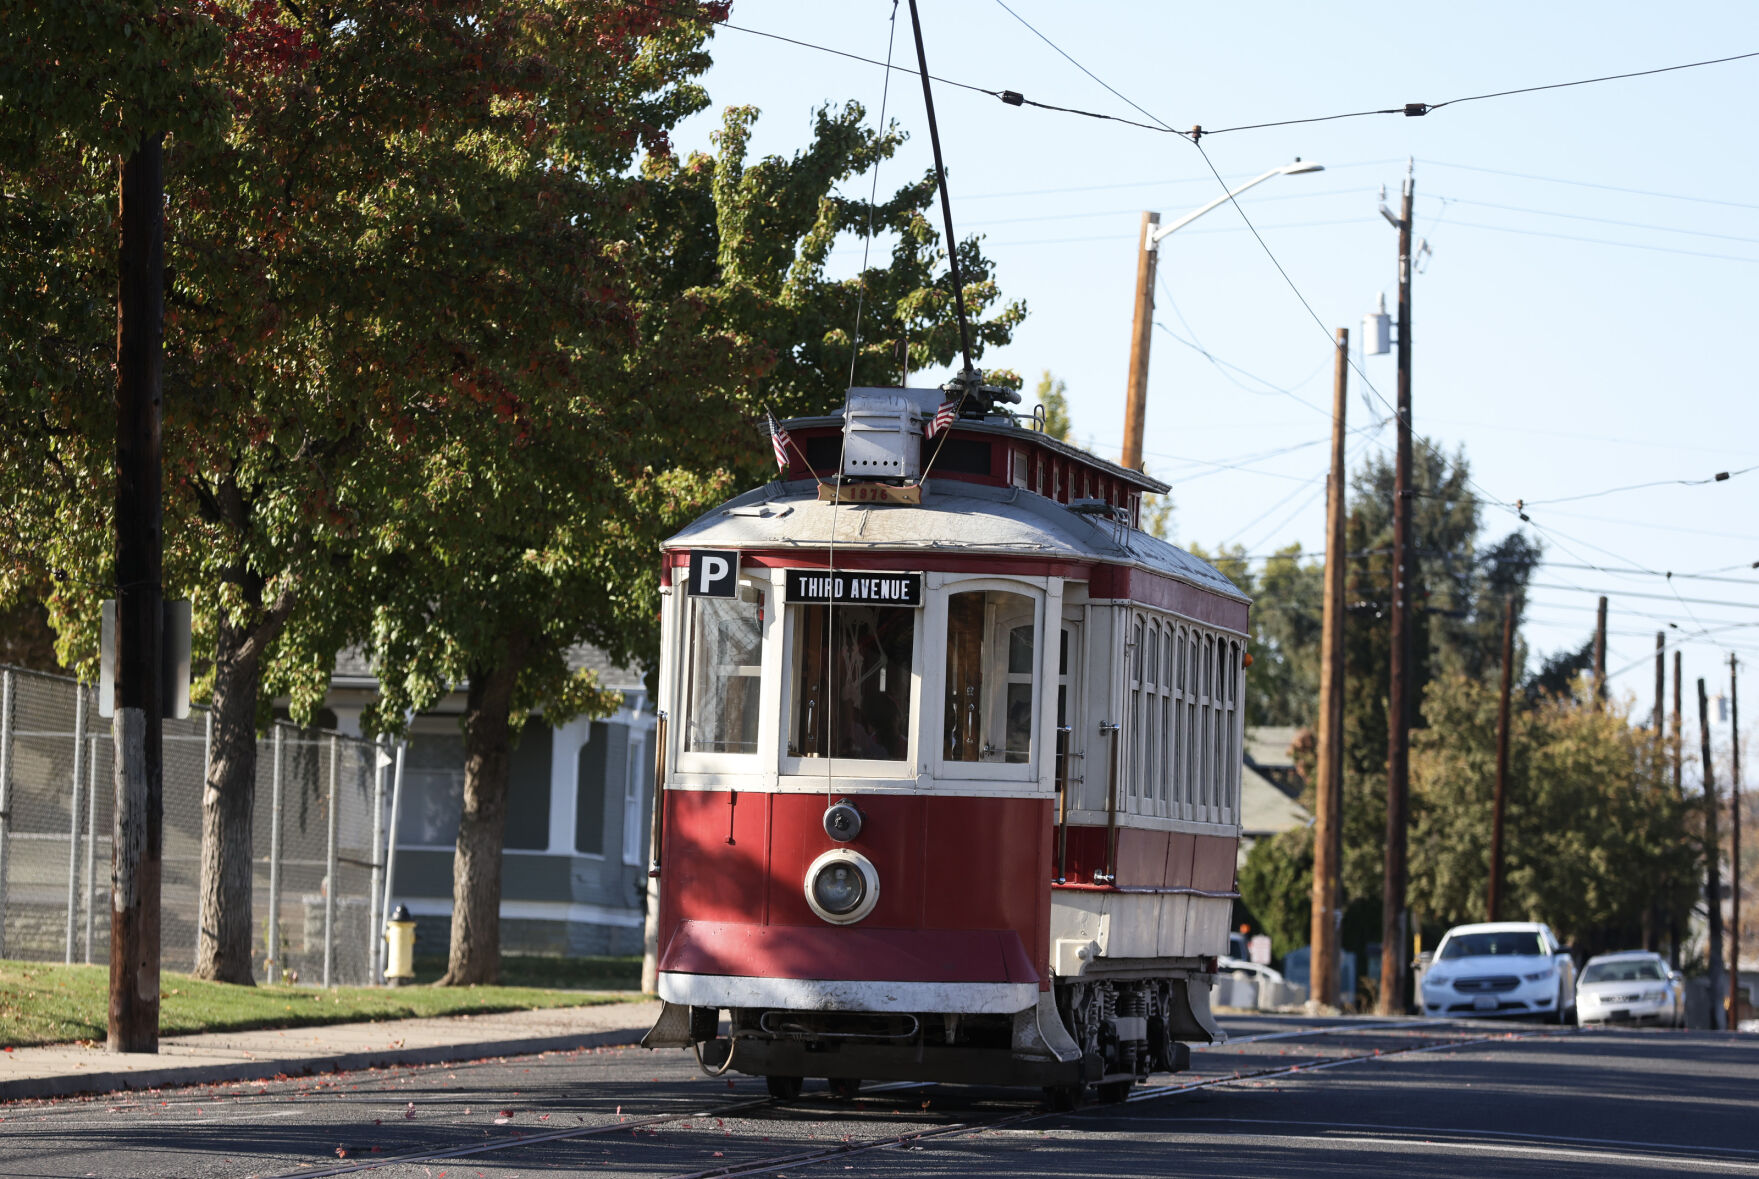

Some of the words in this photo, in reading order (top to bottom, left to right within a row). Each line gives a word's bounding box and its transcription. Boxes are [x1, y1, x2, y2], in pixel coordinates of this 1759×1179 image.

[700, 556, 729, 593] P
[799, 577, 844, 598] THIRD
[850, 579, 910, 600] AVENUE
